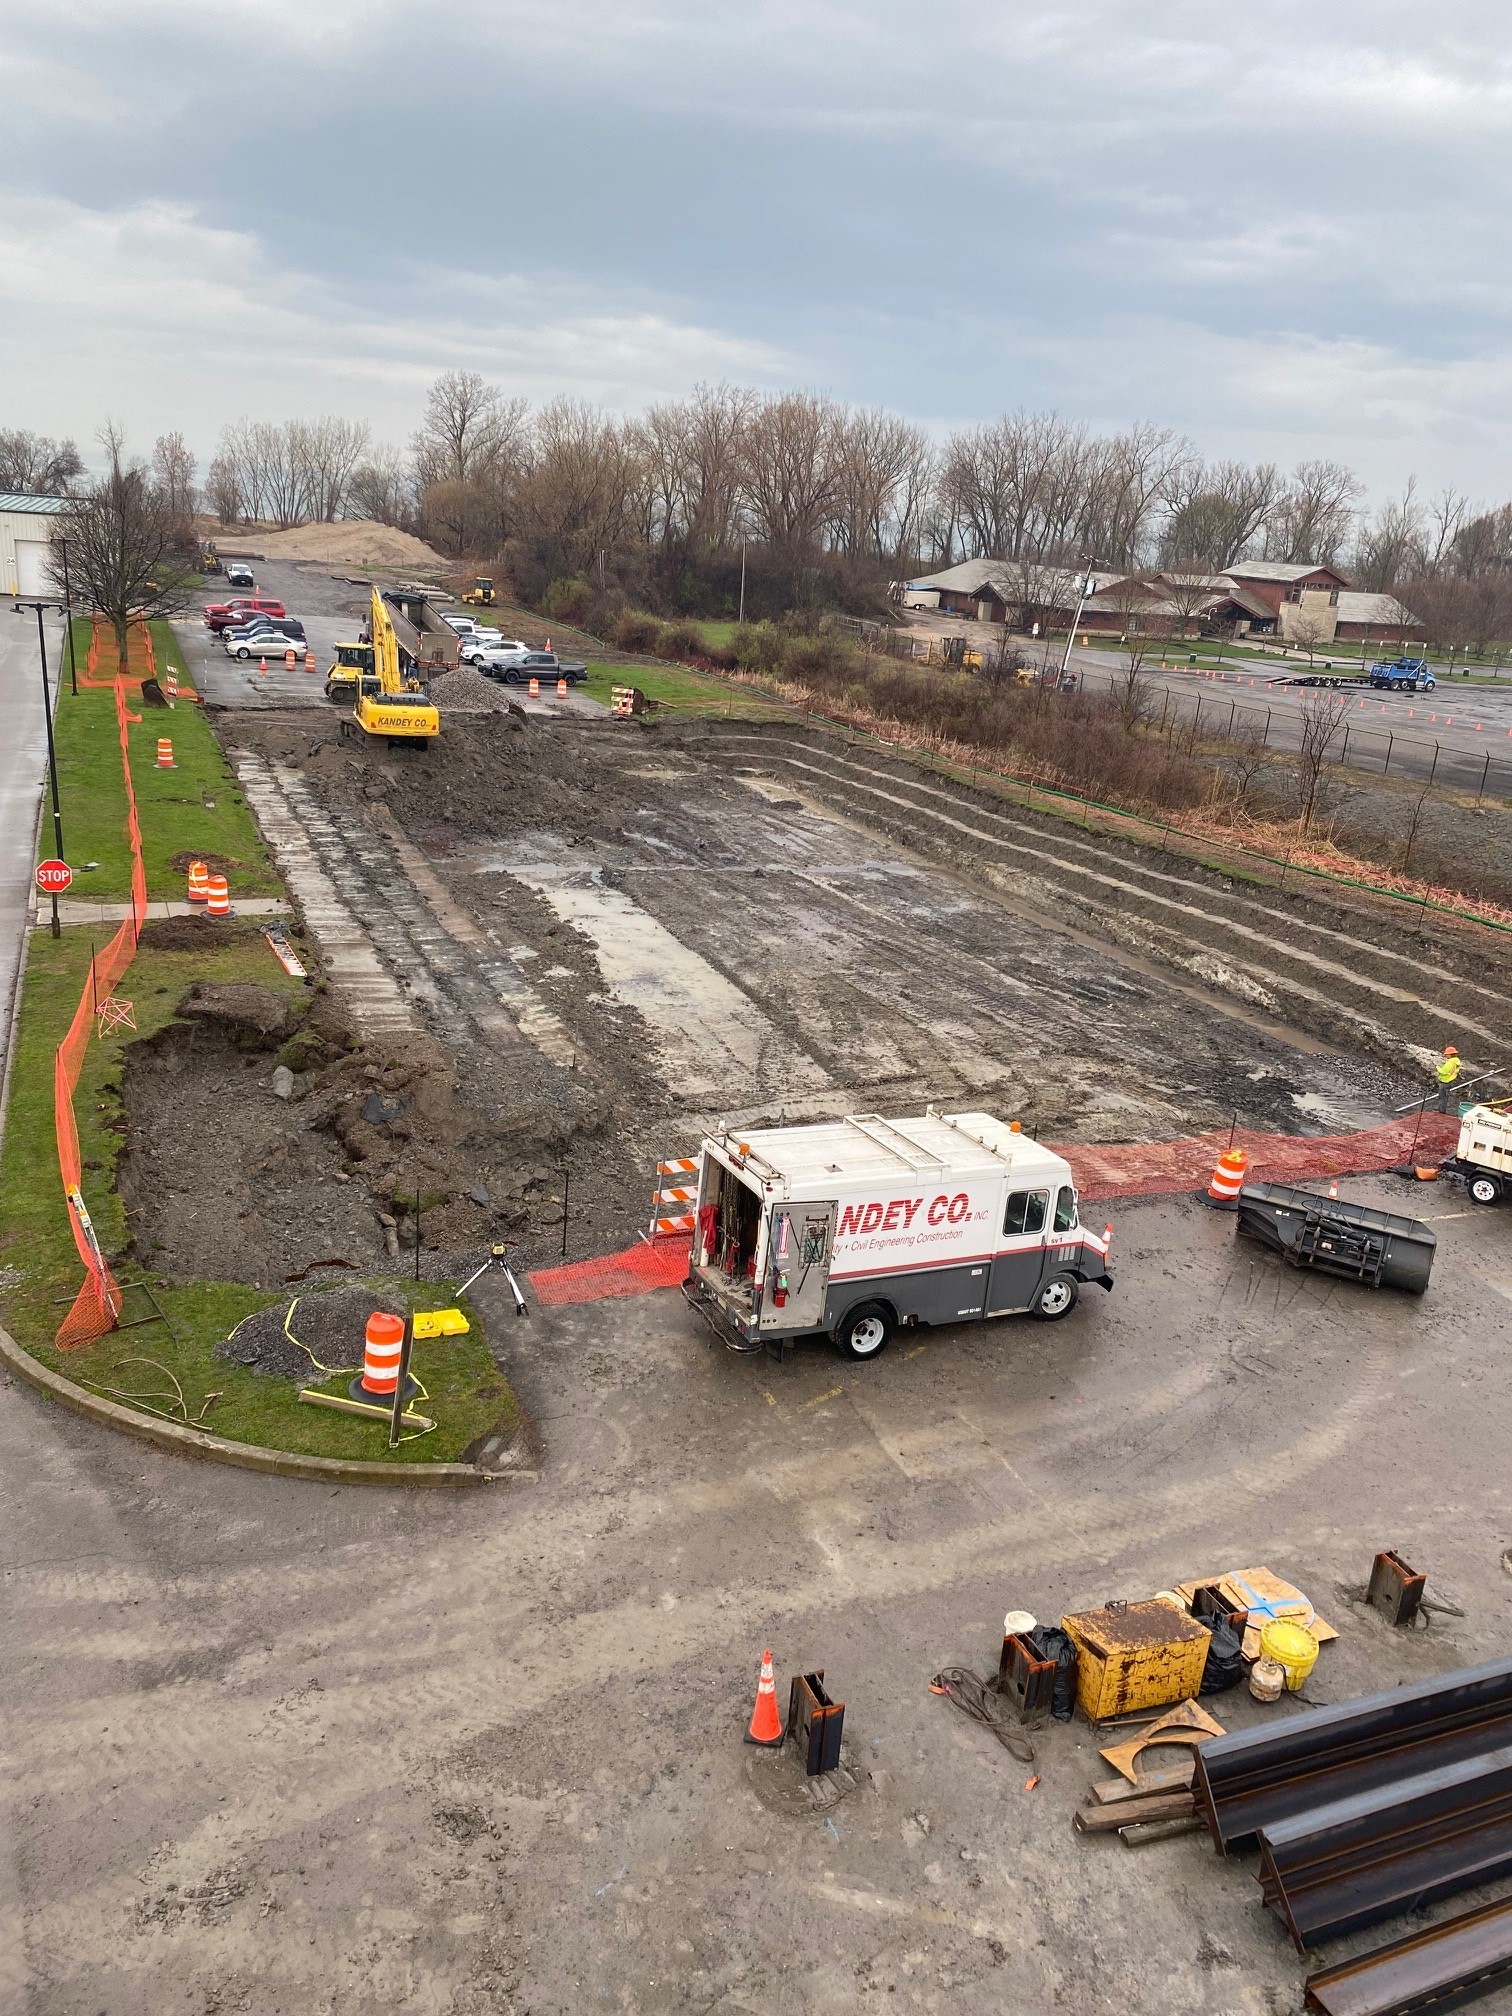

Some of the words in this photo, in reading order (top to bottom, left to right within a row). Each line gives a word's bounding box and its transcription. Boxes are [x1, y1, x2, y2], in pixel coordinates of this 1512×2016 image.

[377, 717, 412, 727] KANDEY
[38, 870, 70, 882] STOP
[834, 1198, 924, 1237] NDEY
[927, 1193, 972, 1226] CO.
[850, 1239, 868, 1251] Civil
[868, 1235, 915, 1251] Engineering
[916, 1230, 964, 1244] Construction
